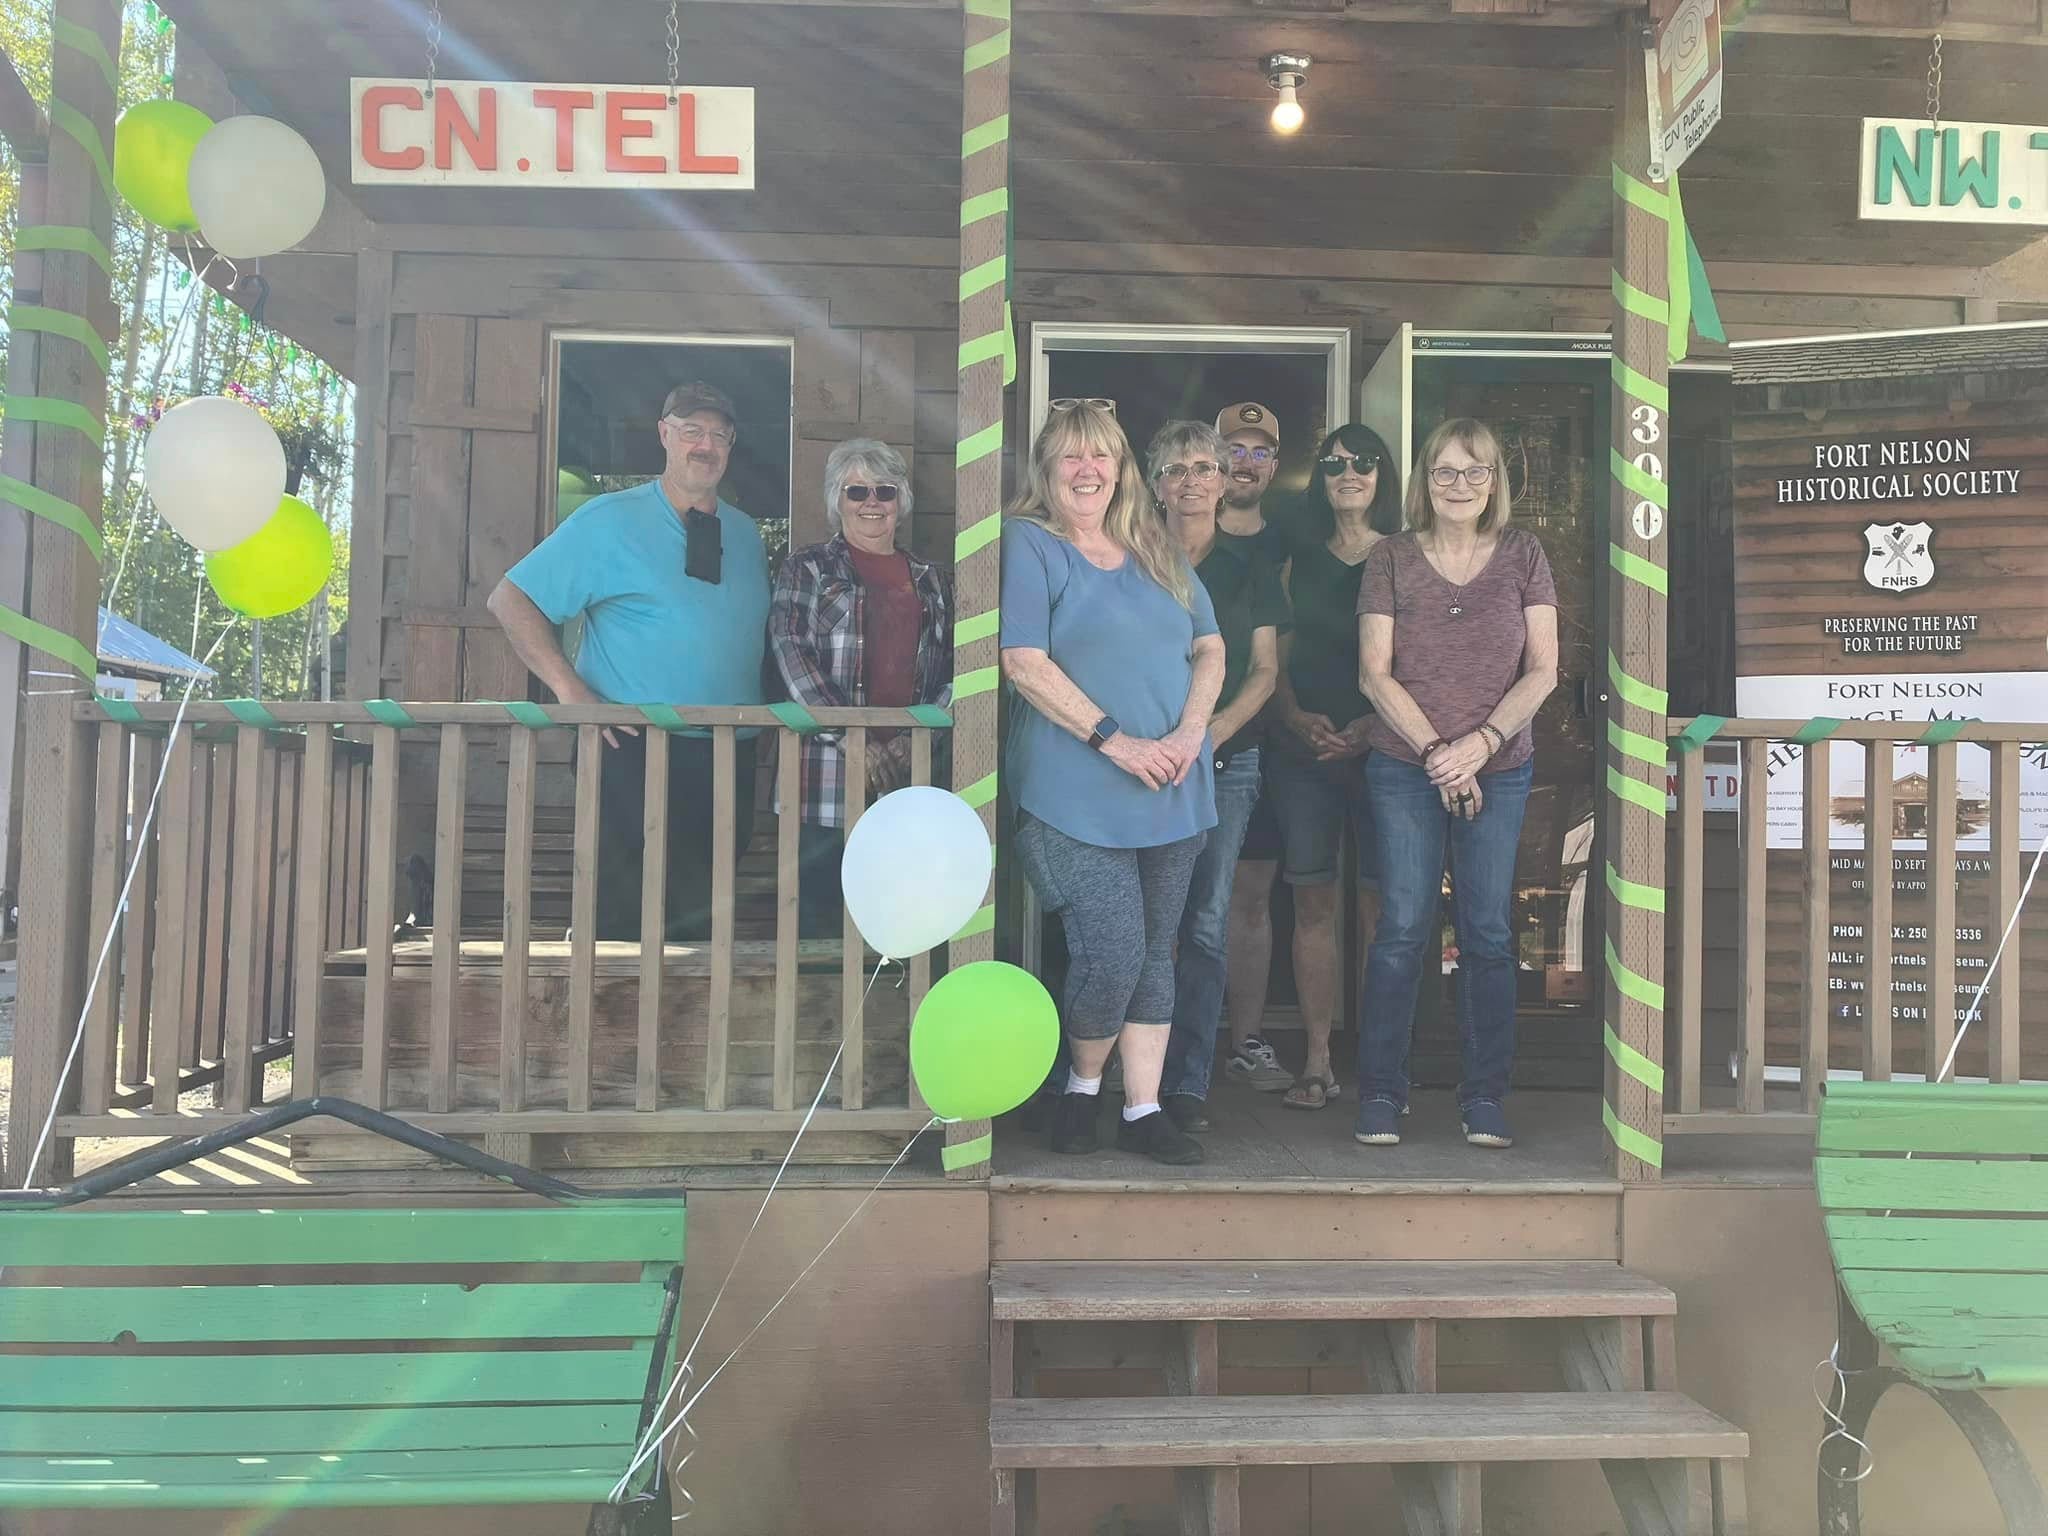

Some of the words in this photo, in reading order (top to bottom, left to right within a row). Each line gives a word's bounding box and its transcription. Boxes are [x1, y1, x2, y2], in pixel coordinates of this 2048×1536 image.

[1664, 122, 1680, 151] CN
[1683, 99, 1705, 131] Public
[1815, 444, 1871, 468] FORT
[1880, 438, 1971, 466] NELSON
[1777, 474, 1914, 503] HISTORICAL
[1923, 470, 2020, 497] SOCIETY
[1881, 576, 1918, 587] FNHS
[1824, 617, 1908, 633] PRESERVING
[1912, 616, 1942, 631] THE
[1946, 615, 1978, 630] PAST
[1844, 637, 1872, 652] FOR
[1875, 636, 1904, 651] THE
[1908, 635, 1962, 651] FUTURE
[1831, 858, 1850, 869] MID
[1974, 860, 1981, 871] A
[1897, 881, 1906, 890] BY
[1829, 978, 1847, 990] EB:
[1903, 1007, 1918, 1019] ON
